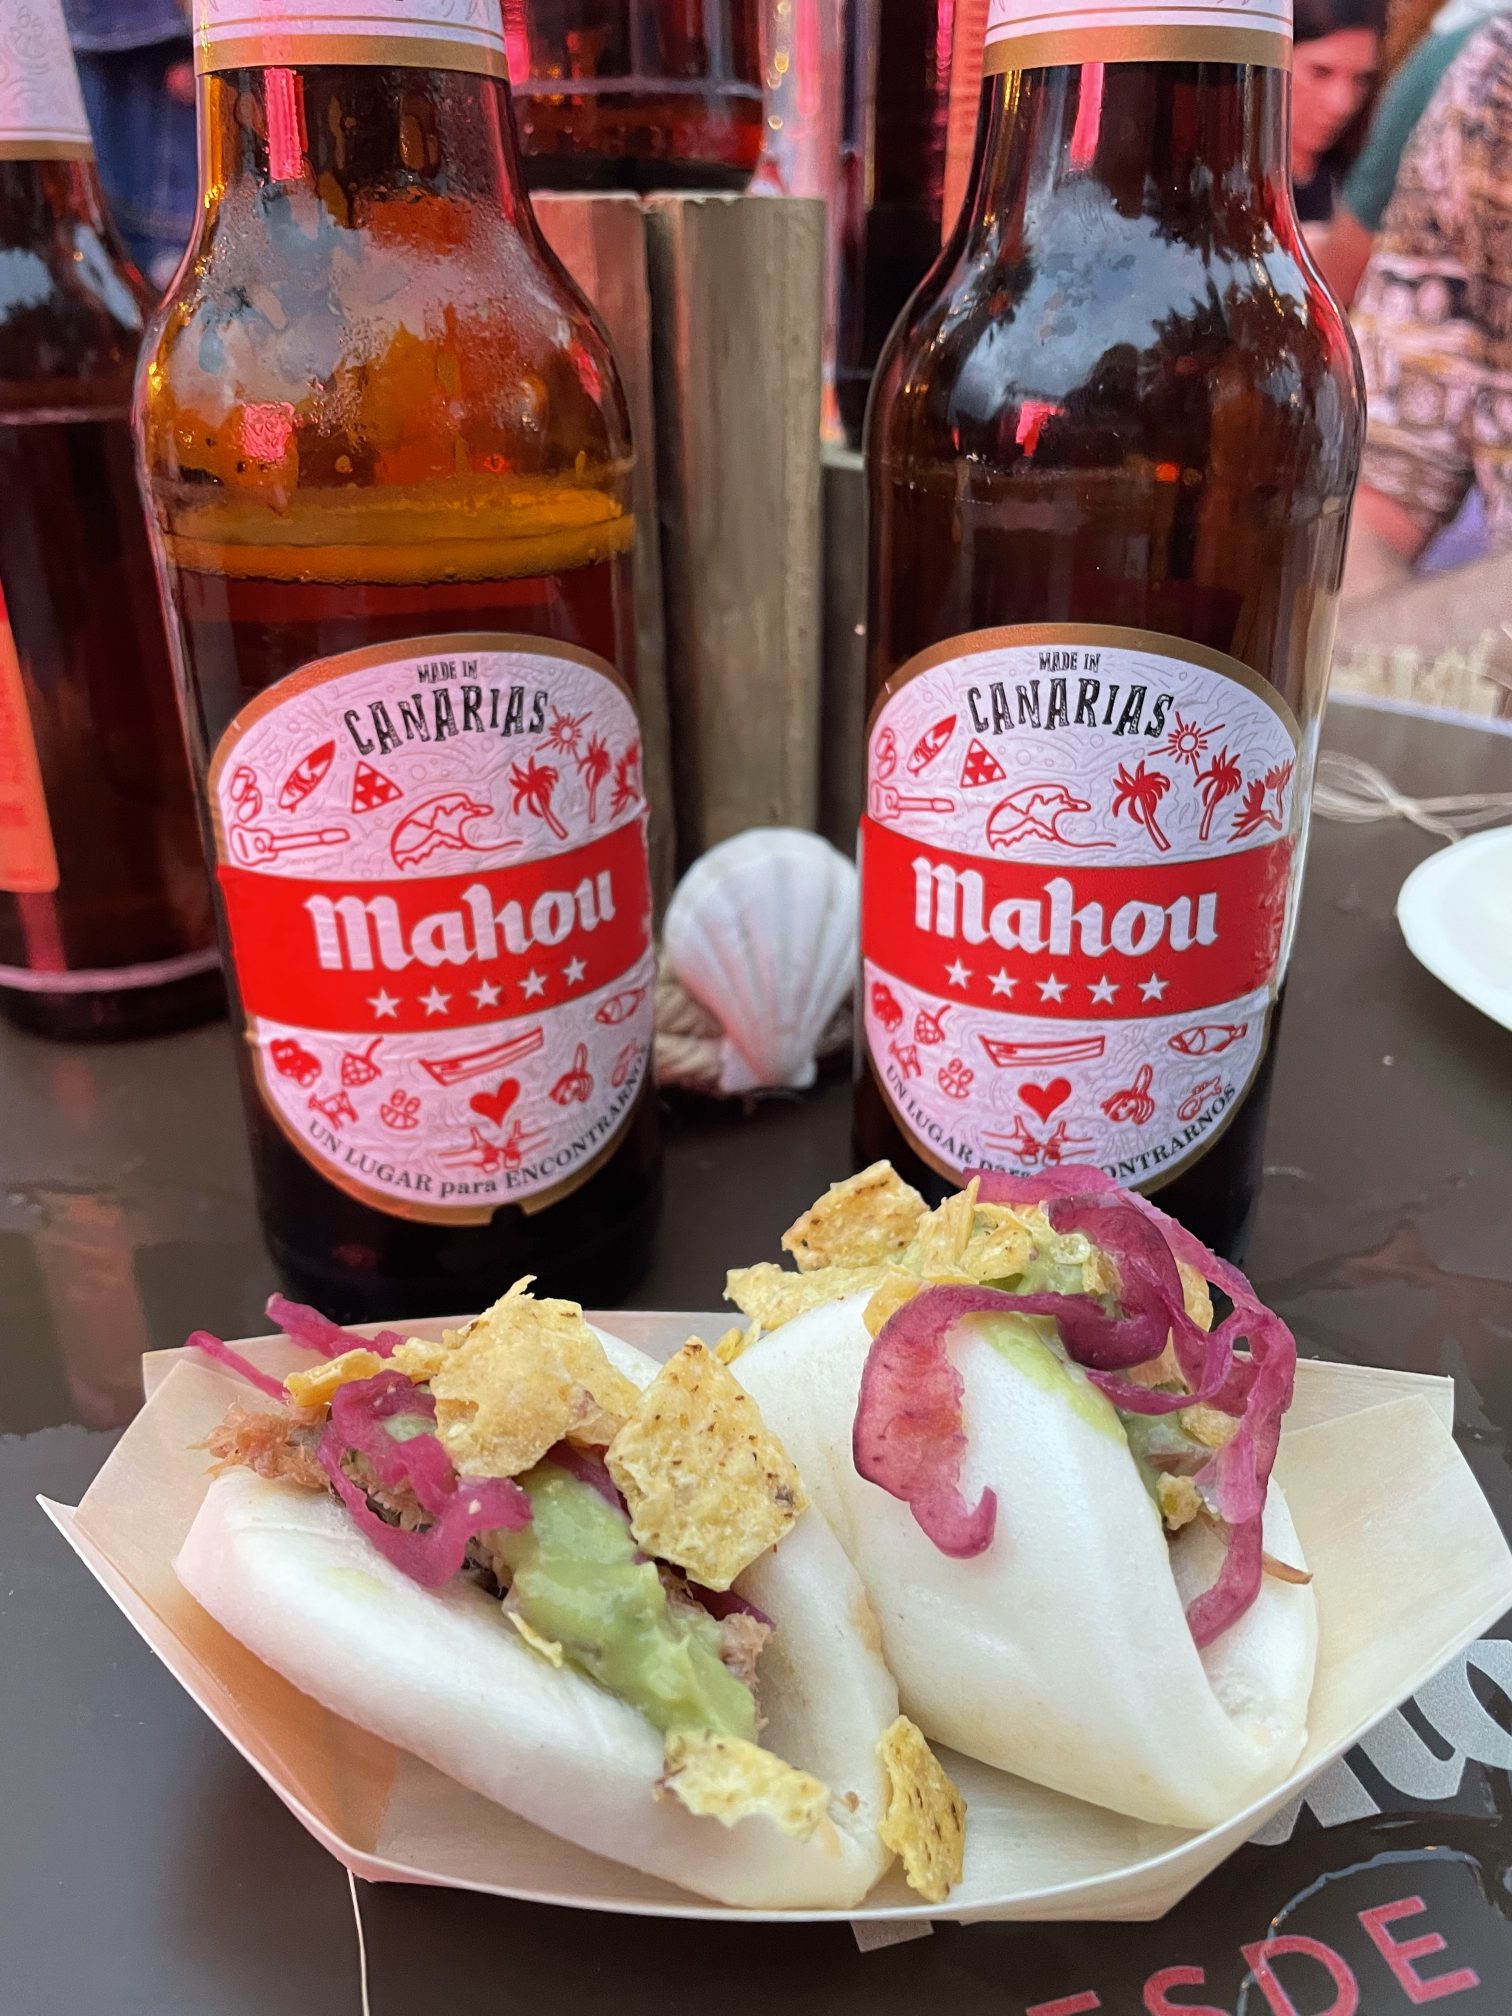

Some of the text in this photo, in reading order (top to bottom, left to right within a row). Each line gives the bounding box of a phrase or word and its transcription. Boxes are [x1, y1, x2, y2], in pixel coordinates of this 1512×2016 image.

[417, 659, 479, 683] MADE IN
[1038, 651, 1101, 674] MADE IN
[343, 685, 549, 756] CANARIAS
[966, 677, 1175, 739] CANARIAS
[304, 870, 617, 971] Mahou
[911, 856, 1220, 958] Mahou
[309, 1119, 342, 1154] UN
[345, 1147, 433, 1193] LUGAR
[440, 1178, 498, 1199] para
[886, 1064, 1237, 1180] UN LUGAR ONTRARNOS
